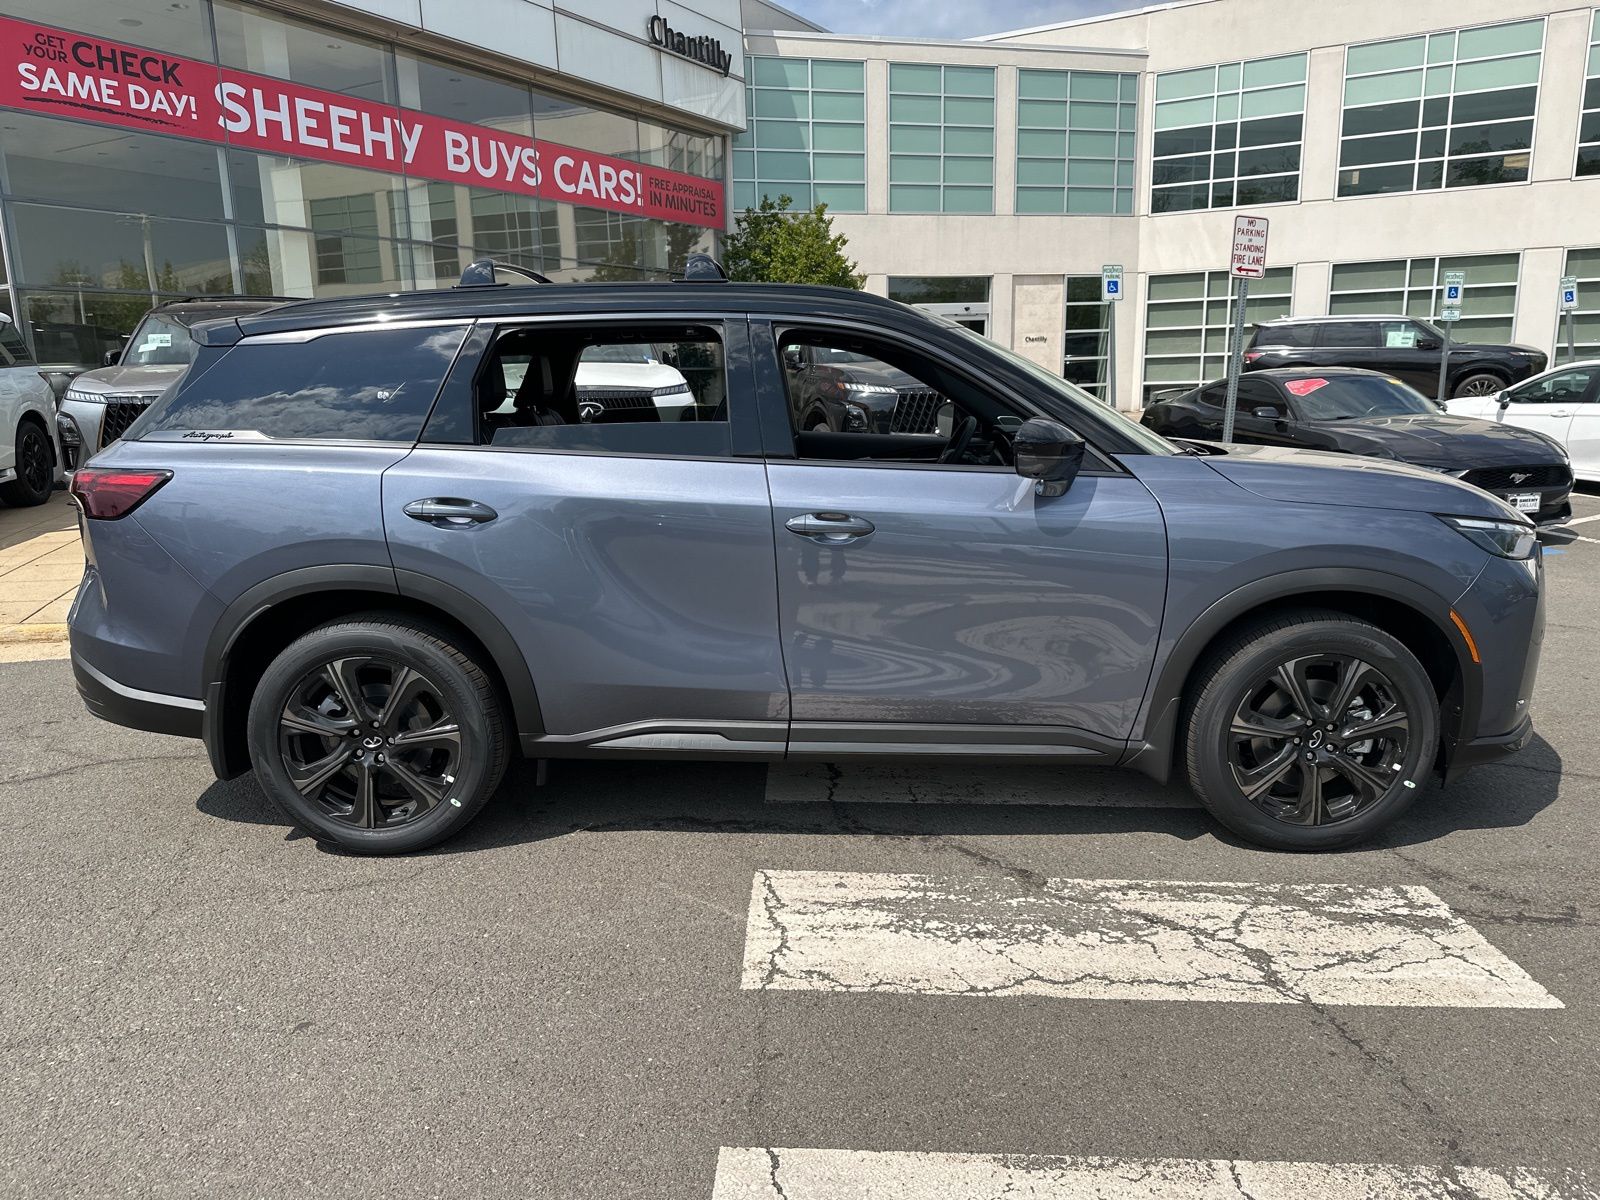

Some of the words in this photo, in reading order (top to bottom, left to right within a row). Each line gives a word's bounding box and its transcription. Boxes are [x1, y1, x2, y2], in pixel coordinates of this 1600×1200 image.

[34, 32, 66, 50] GET
[649, 14, 732, 78] Chantilly
[22, 43, 68, 64] YOUR
[71, 41, 183, 87] CHECK
[17, 62, 121, 106] SAME
[127, 83, 198, 120] DAY!
[214, 82, 424, 164] SHEEHY
[444, 130, 542, 187] BUYS
[553, 155, 644, 207] CARS!
[649, 177, 672, 192] FREE
[672, 183, 716, 201] APPRAISAL
[650, 191, 662, 207] IN
[665, 193, 716, 217] MINUTES
[1237, 228, 1265, 238] PARKING
[1247, 219, 1256, 227] NO
[1235, 243, 1264, 253] STANDING
[1233, 254, 1246, 264] FIRE
[1248, 256, 1263, 265] LANE
